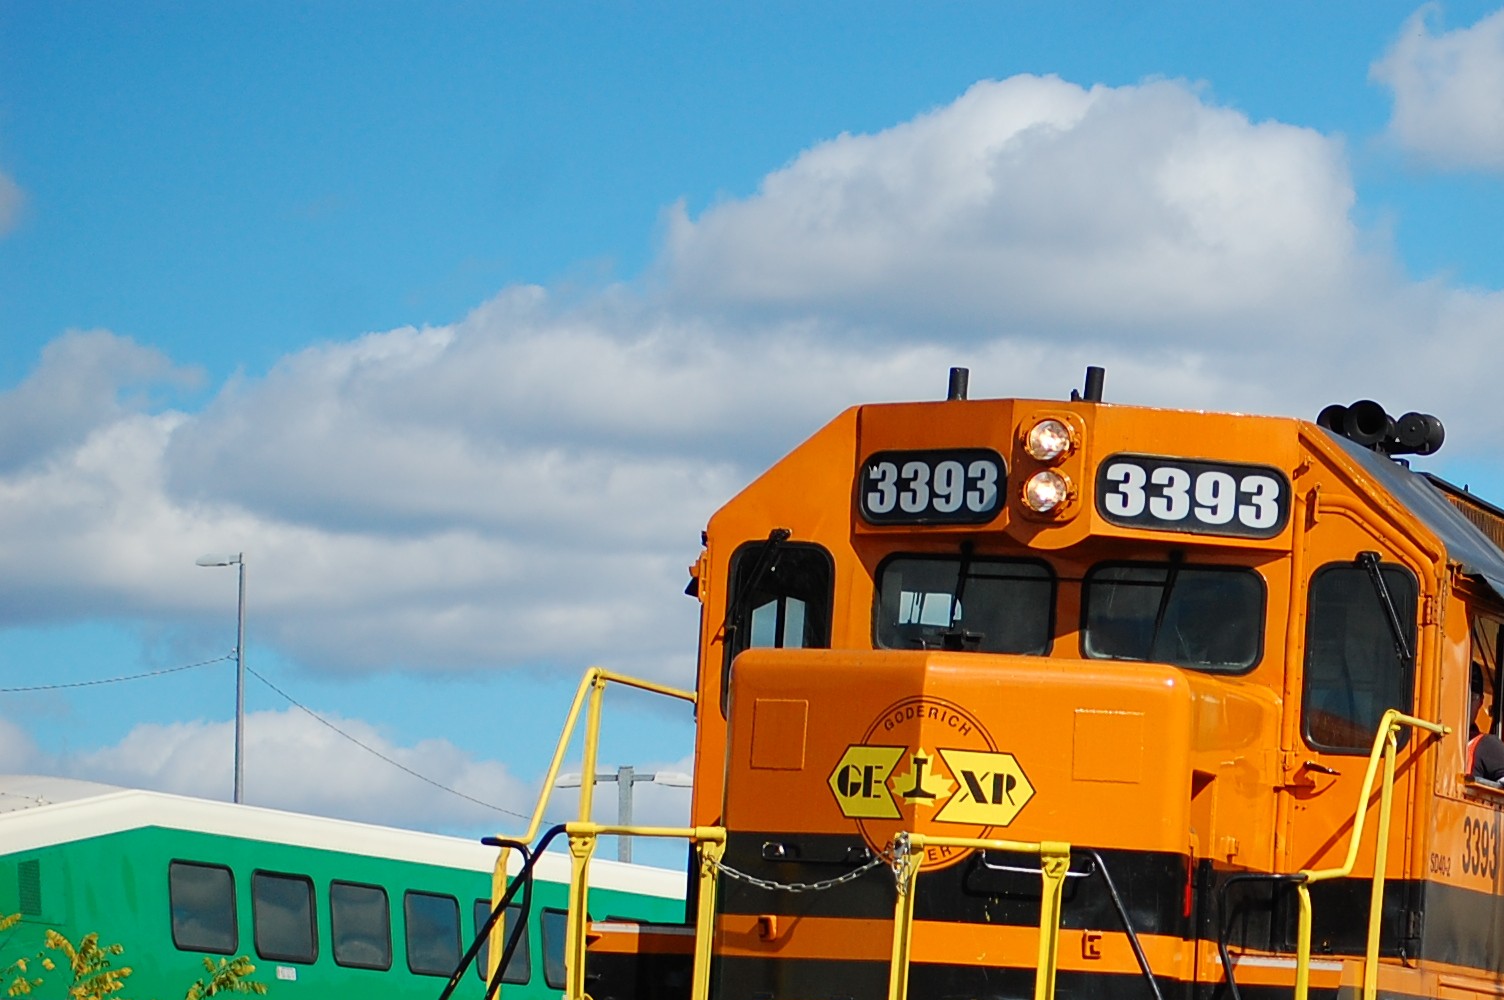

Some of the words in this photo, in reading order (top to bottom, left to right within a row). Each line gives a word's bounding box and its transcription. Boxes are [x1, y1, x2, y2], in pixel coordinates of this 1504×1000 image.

[867, 460, 998, 513] 3393
[1105, 463, 1280, 529] 3393
[884, 704, 972, 737] GODERICH
[1462, 816, 1498, 880] 3393
